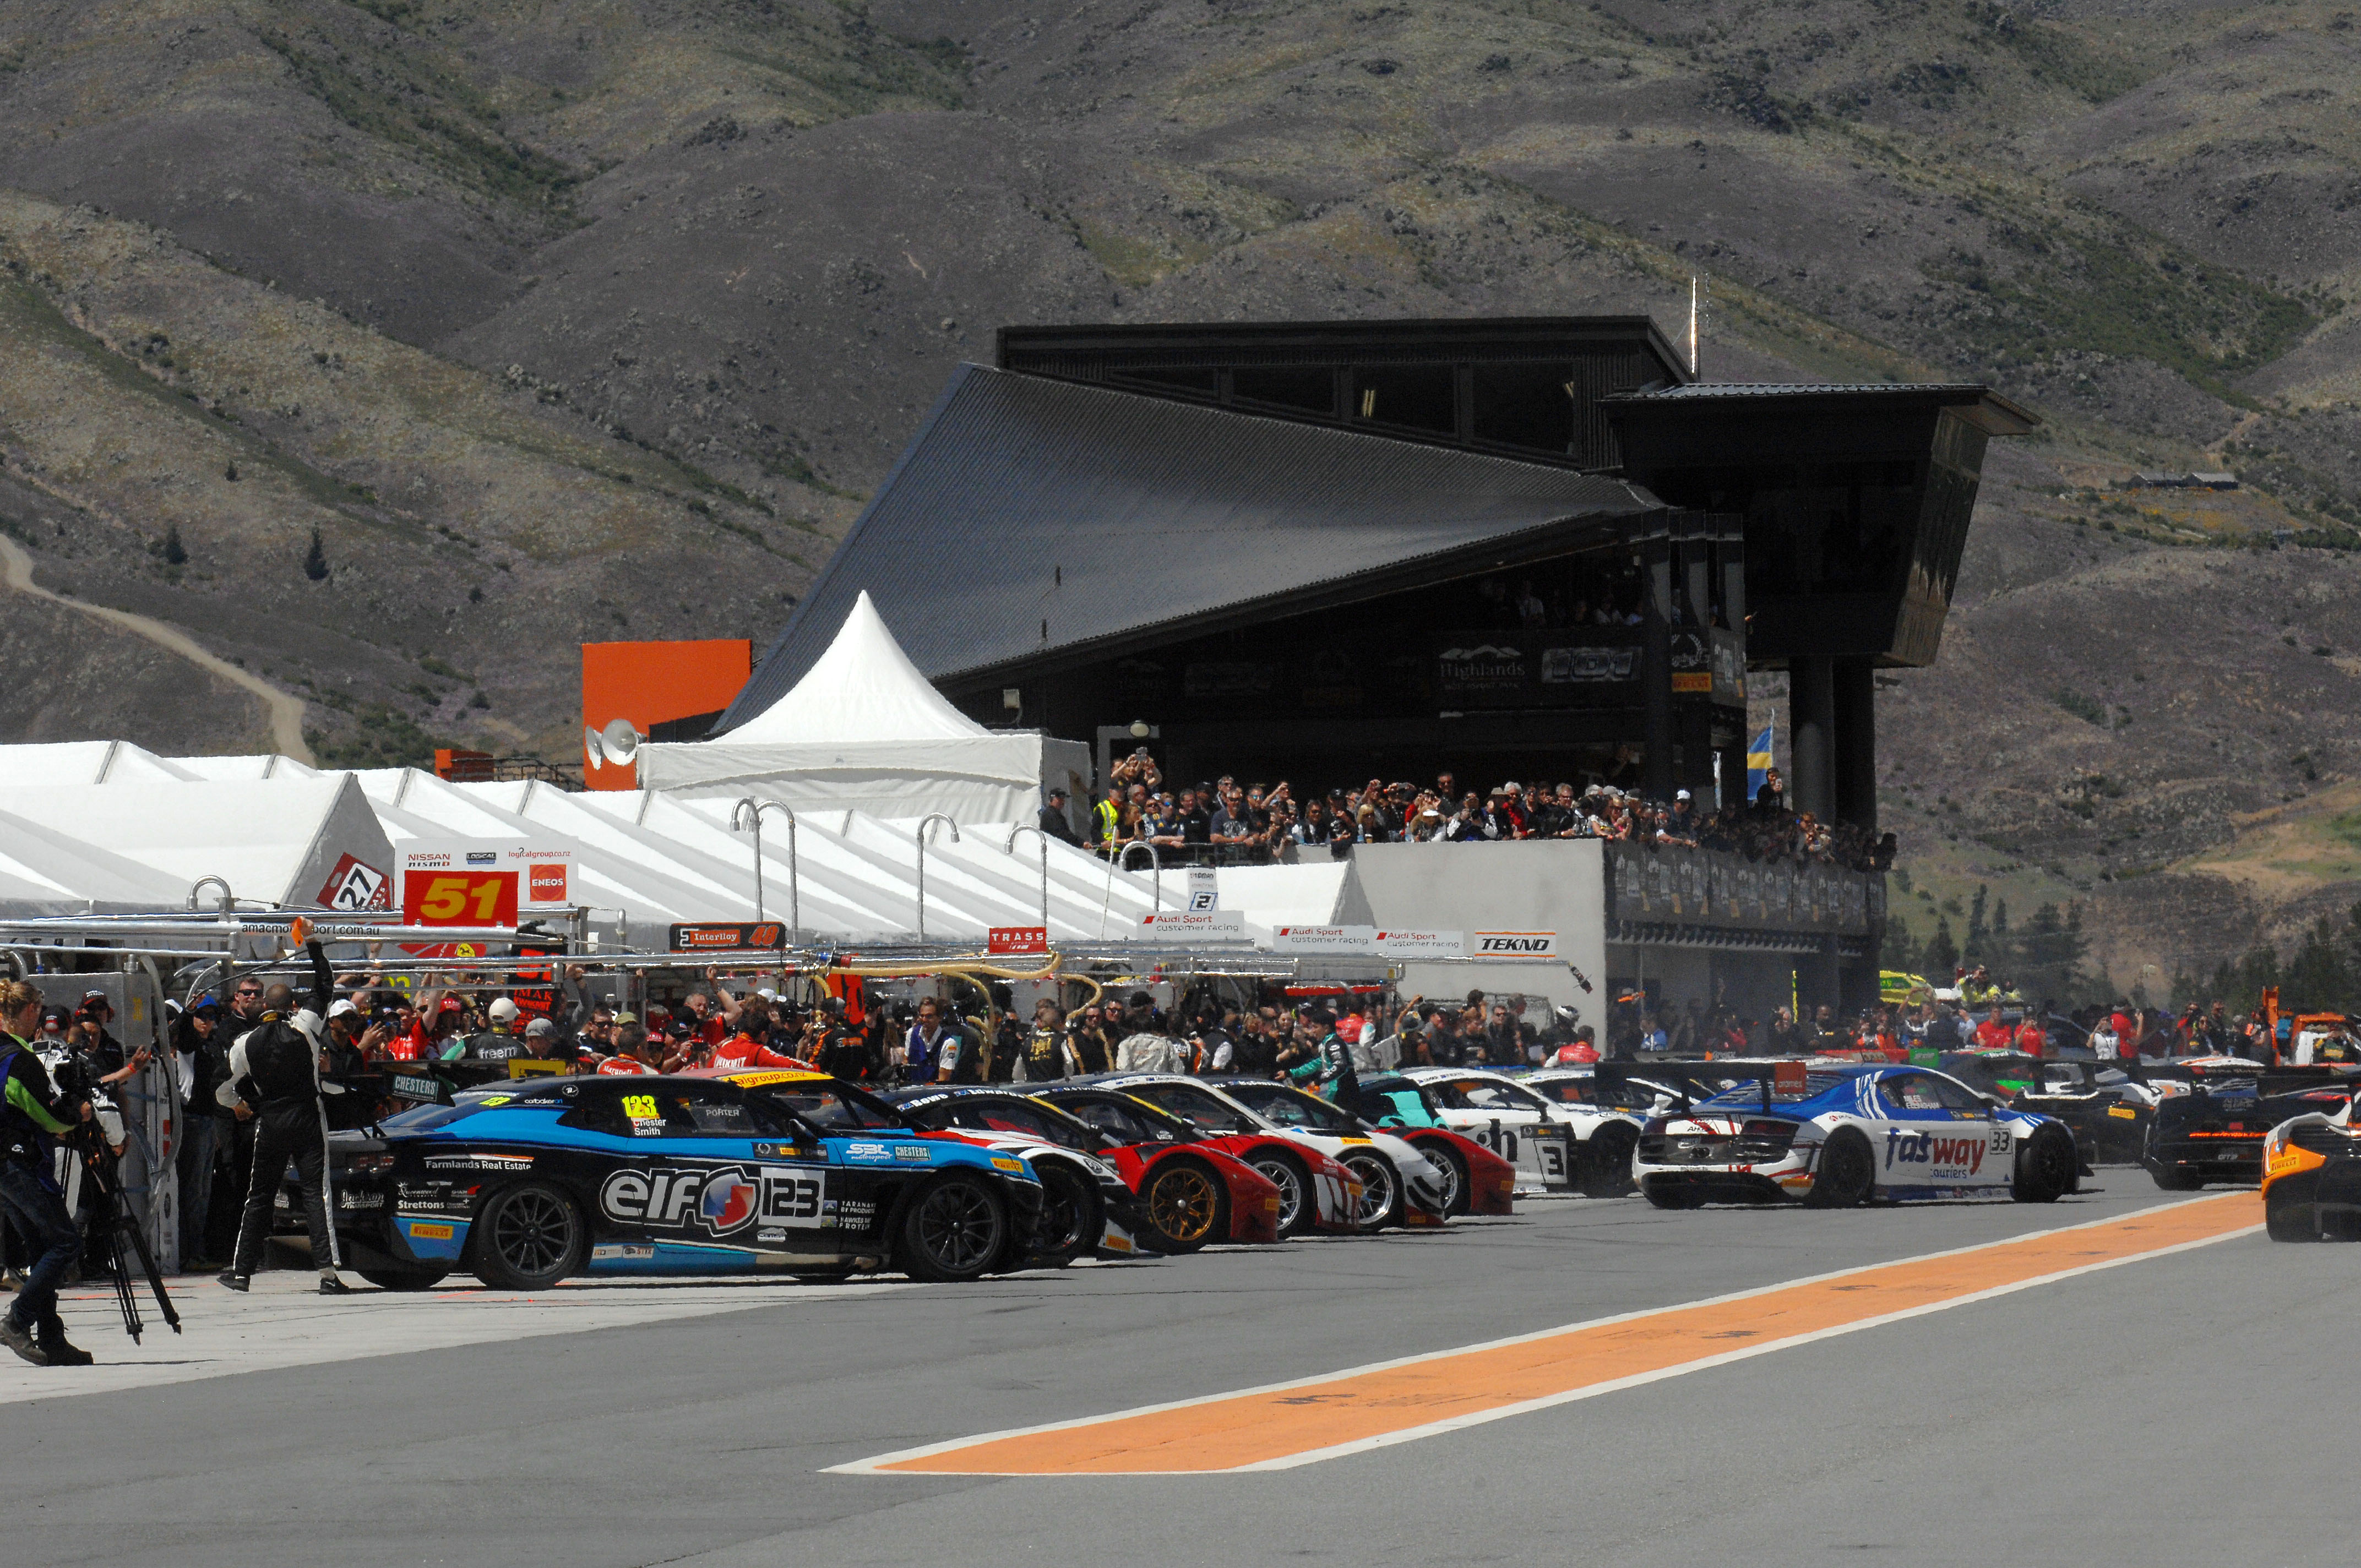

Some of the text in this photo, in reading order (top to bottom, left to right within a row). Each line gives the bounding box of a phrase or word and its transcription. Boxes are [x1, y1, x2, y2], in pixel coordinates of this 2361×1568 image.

[1440, 662, 1525, 679] Highlands
[339, 868, 372, 909] 27
[532, 878, 563, 886] ENEOS
[420, 878, 502, 919] 51
[1196, 895, 1211, 908] 2
[694, 933, 737, 941] Interlloy
[748, 925, 779, 946] 48
[992, 932, 1044, 941] TRASS
[1482, 938, 1549, 951] TEKNO
[395, 1076, 436, 1095] CHESTERS
[622, 1095, 657, 1117] 123
[634, 1118, 666, 1127] Chester
[1992, 1131, 2010, 1152] 33
[851, 1154, 893, 1162] motorsport
[896, 1146, 927, 1157] CHESTERS
[426, 1160, 531, 1170] Farmlands Real Estate
[994, 1161, 1021, 1169] PIRELLI
[1542, 1146, 1564, 1175] 3
[2271, 1158, 2296, 1170] PIRELLI
[341, 1189, 384, 1208] Jackson
[606, 1175, 700, 1219] elf
[762, 1178, 820, 1218] 123
[398, 1200, 444, 1209] Strettons
